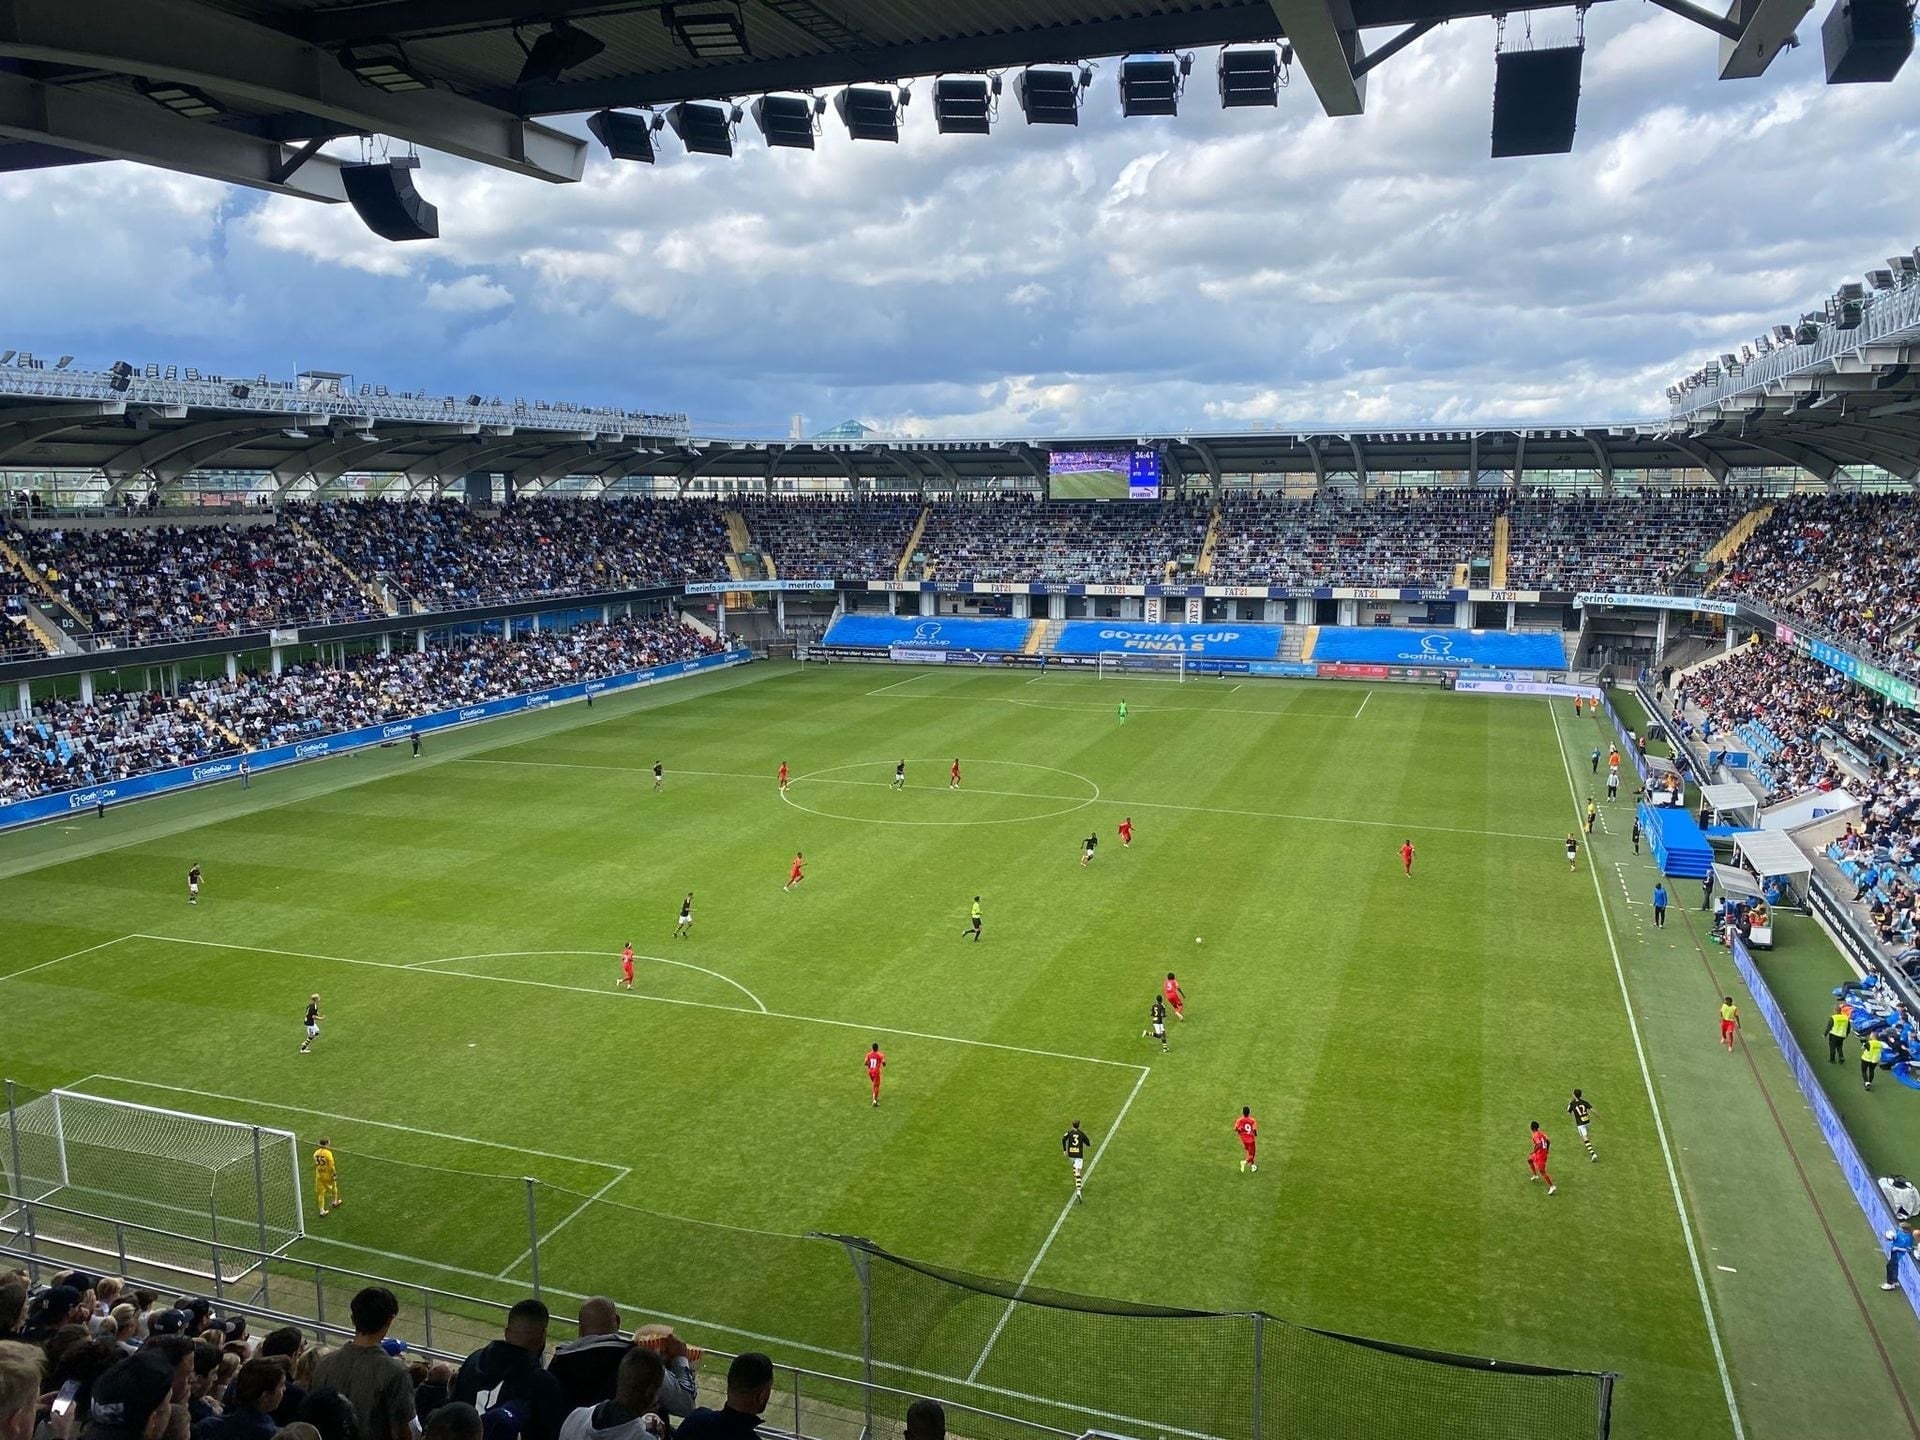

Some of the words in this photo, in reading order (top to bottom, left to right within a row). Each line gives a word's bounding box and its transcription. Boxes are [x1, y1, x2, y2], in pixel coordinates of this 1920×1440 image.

[690, 584, 725, 592] merinfo.se
[788, 580, 832, 589] merinfo.se
[1104, 586, 1126, 594] FAT21
[1354, 590, 1378, 598] FAT21
[1491, 592, 1516, 600] FAT21
[1148, 600, 1157, 622] FAT21
[1190, 600, 1198, 624] FAT21
[1701, 602, 1734, 614] merinfo.se
[62, 619, 74, 628] D5
[1100, 630, 1184, 641] GOTHIA
[1190, 632, 1240, 642] CUP
[1124, 641, 1205, 651] FINALS
[1398, 652, 1444, 661] Gothia
[202, 765, 220, 774] Gothia
[1576, 1104, 1587, 1116] 12
[1244, 1124, 1252, 1134] 9
[1072, 1134, 1079, 1145] 3
[316, 1156, 325, 1166] 35
